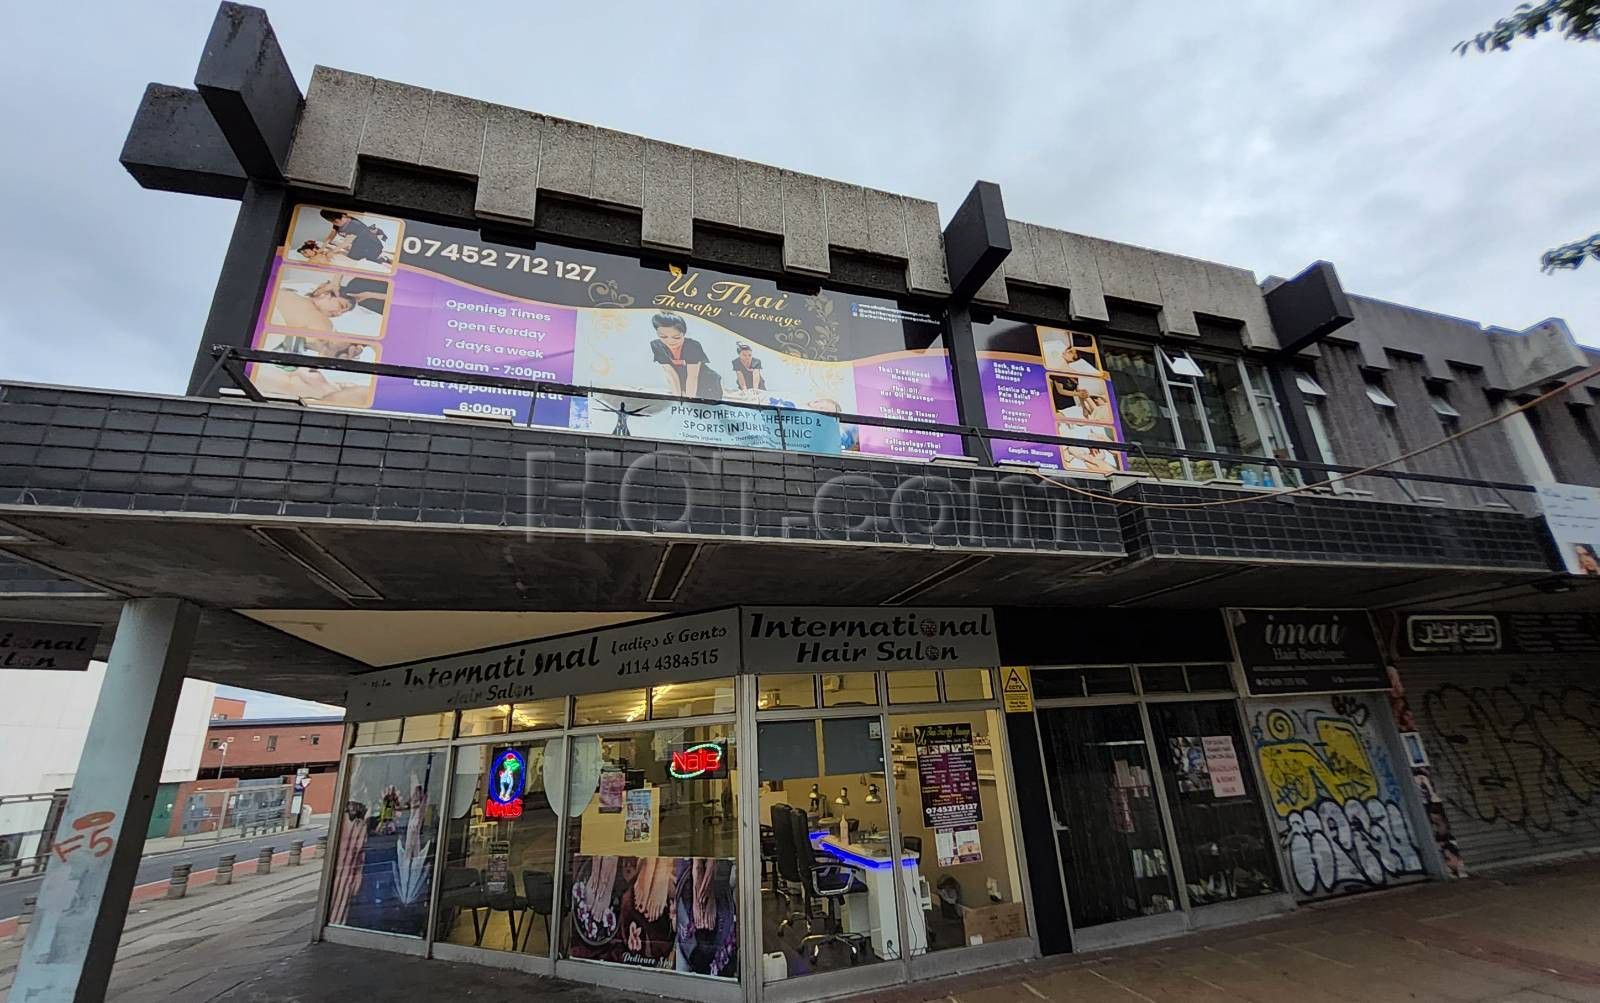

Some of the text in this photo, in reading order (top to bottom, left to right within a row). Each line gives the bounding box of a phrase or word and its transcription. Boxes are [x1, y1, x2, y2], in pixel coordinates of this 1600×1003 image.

[403, 236, 597, 283] 07452 712 127
[706, 281, 790, 311] Thai
[446, 299, 551, 321] Opening Times
[652, 294, 801, 328] Therapy Massage
[447, 319, 546, 342] Open Everday
[444, 338, 544, 360] 7 days a week
[426, 356, 489, 373] 10:00am
[503, 364, 556, 381] 7:00pm
[412, 378, 445, 389] Last
[459, 402, 517, 417] 6:00pm
[671, 405, 757, 422] PHYSIOTHERAPY
[815, 418, 822, 427] &
[684, 419, 724, 433] SPORTS
[774, 428, 812, 440] CLINIC
[750, 613, 992, 639] International
[1264, 614, 1344, 646] imai
[611, 636, 658, 656] Ladies
[663, 631, 673, 645] &
[678, 626, 727, 643] Gents
[796, 640, 959, 664] Hair Salon
[655, 648, 719, 671] 4384515
[485, 798, 523, 818] NAILS
[622, 951, 656, 965] Pedicure
